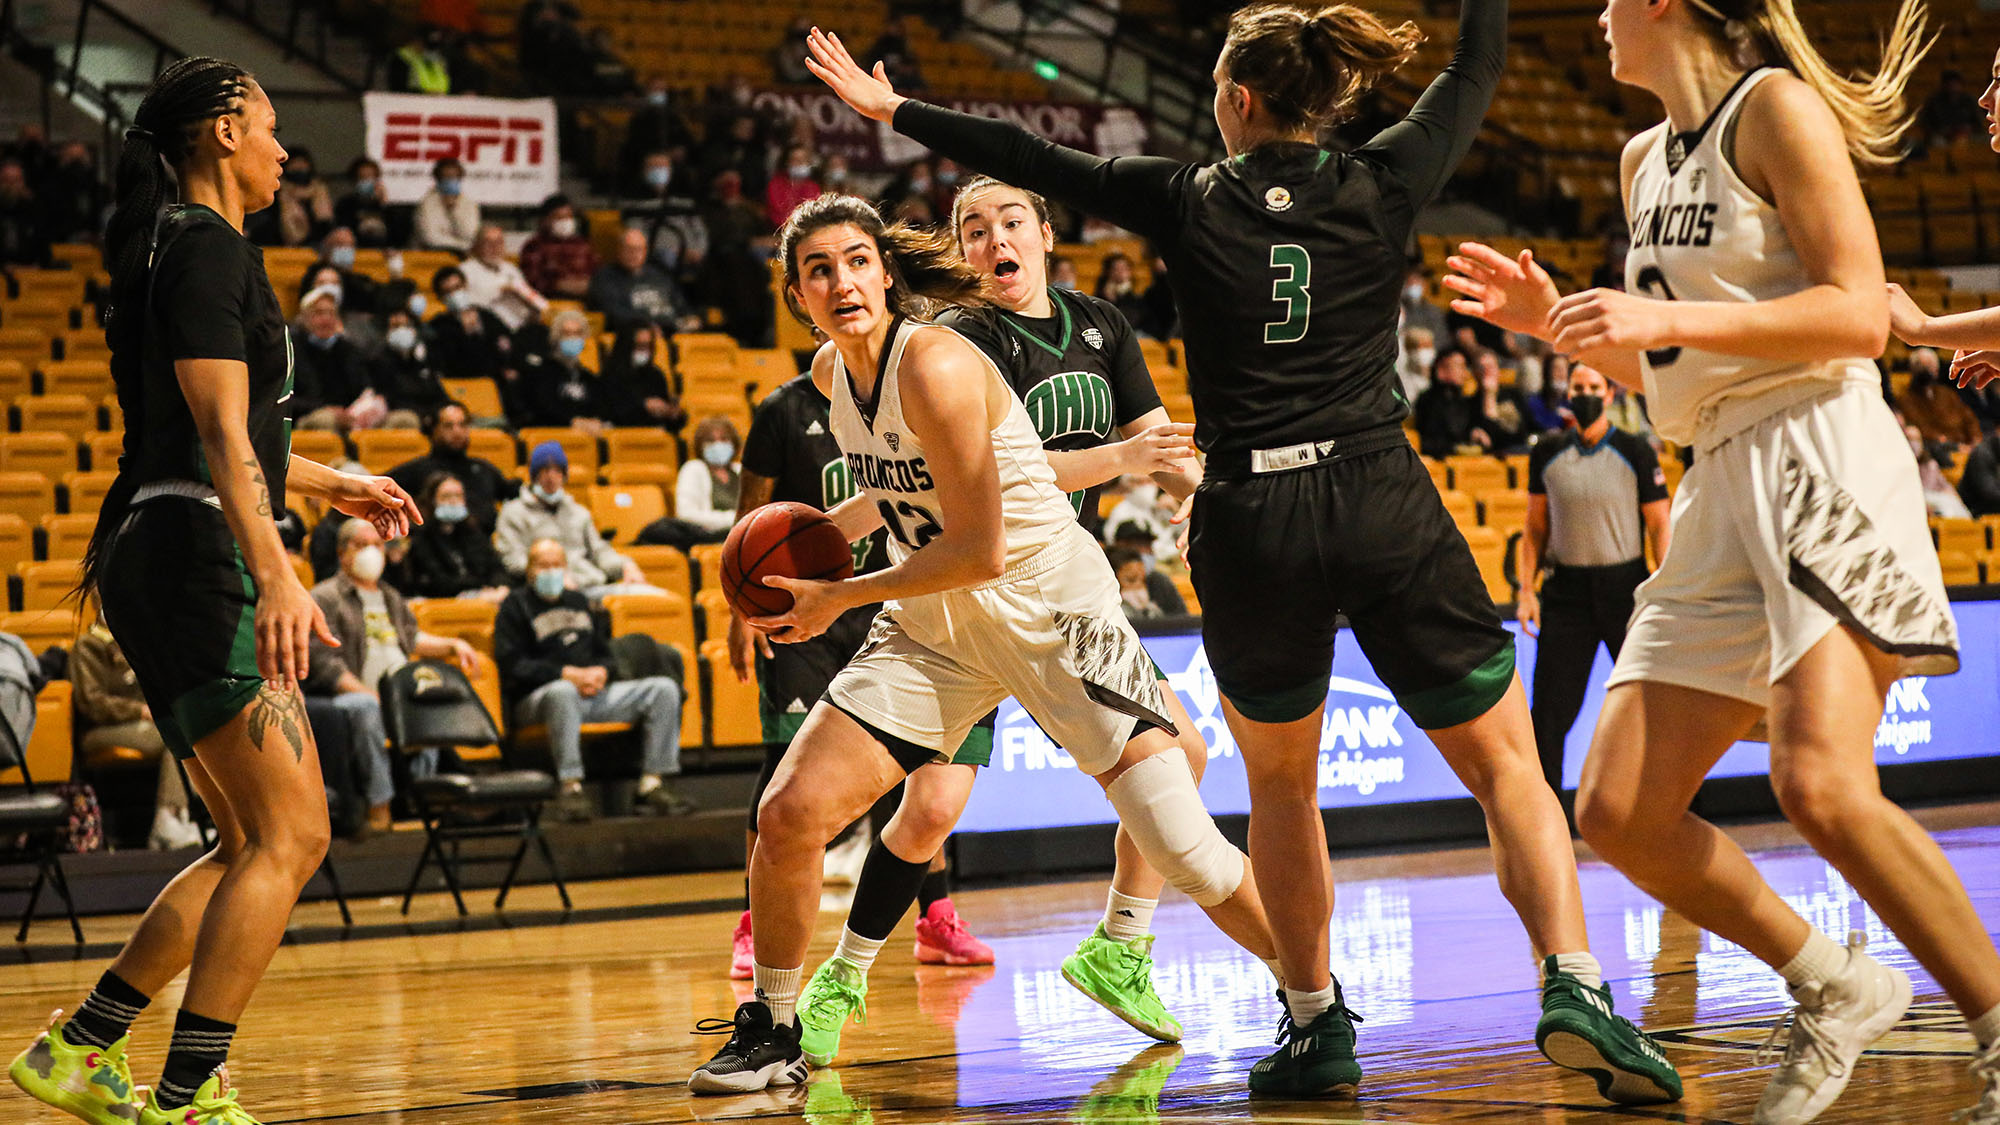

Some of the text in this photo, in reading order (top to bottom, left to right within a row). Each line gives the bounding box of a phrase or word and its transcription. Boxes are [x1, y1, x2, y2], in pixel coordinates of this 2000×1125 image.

[384, 113, 543, 166] ESPN
[1265, 243, 1312, 344] 3
[1024, 371, 1113, 444] OHIO
[847, 452, 935, 493] BRONCOS
[876, 499, 944, 551] 12
